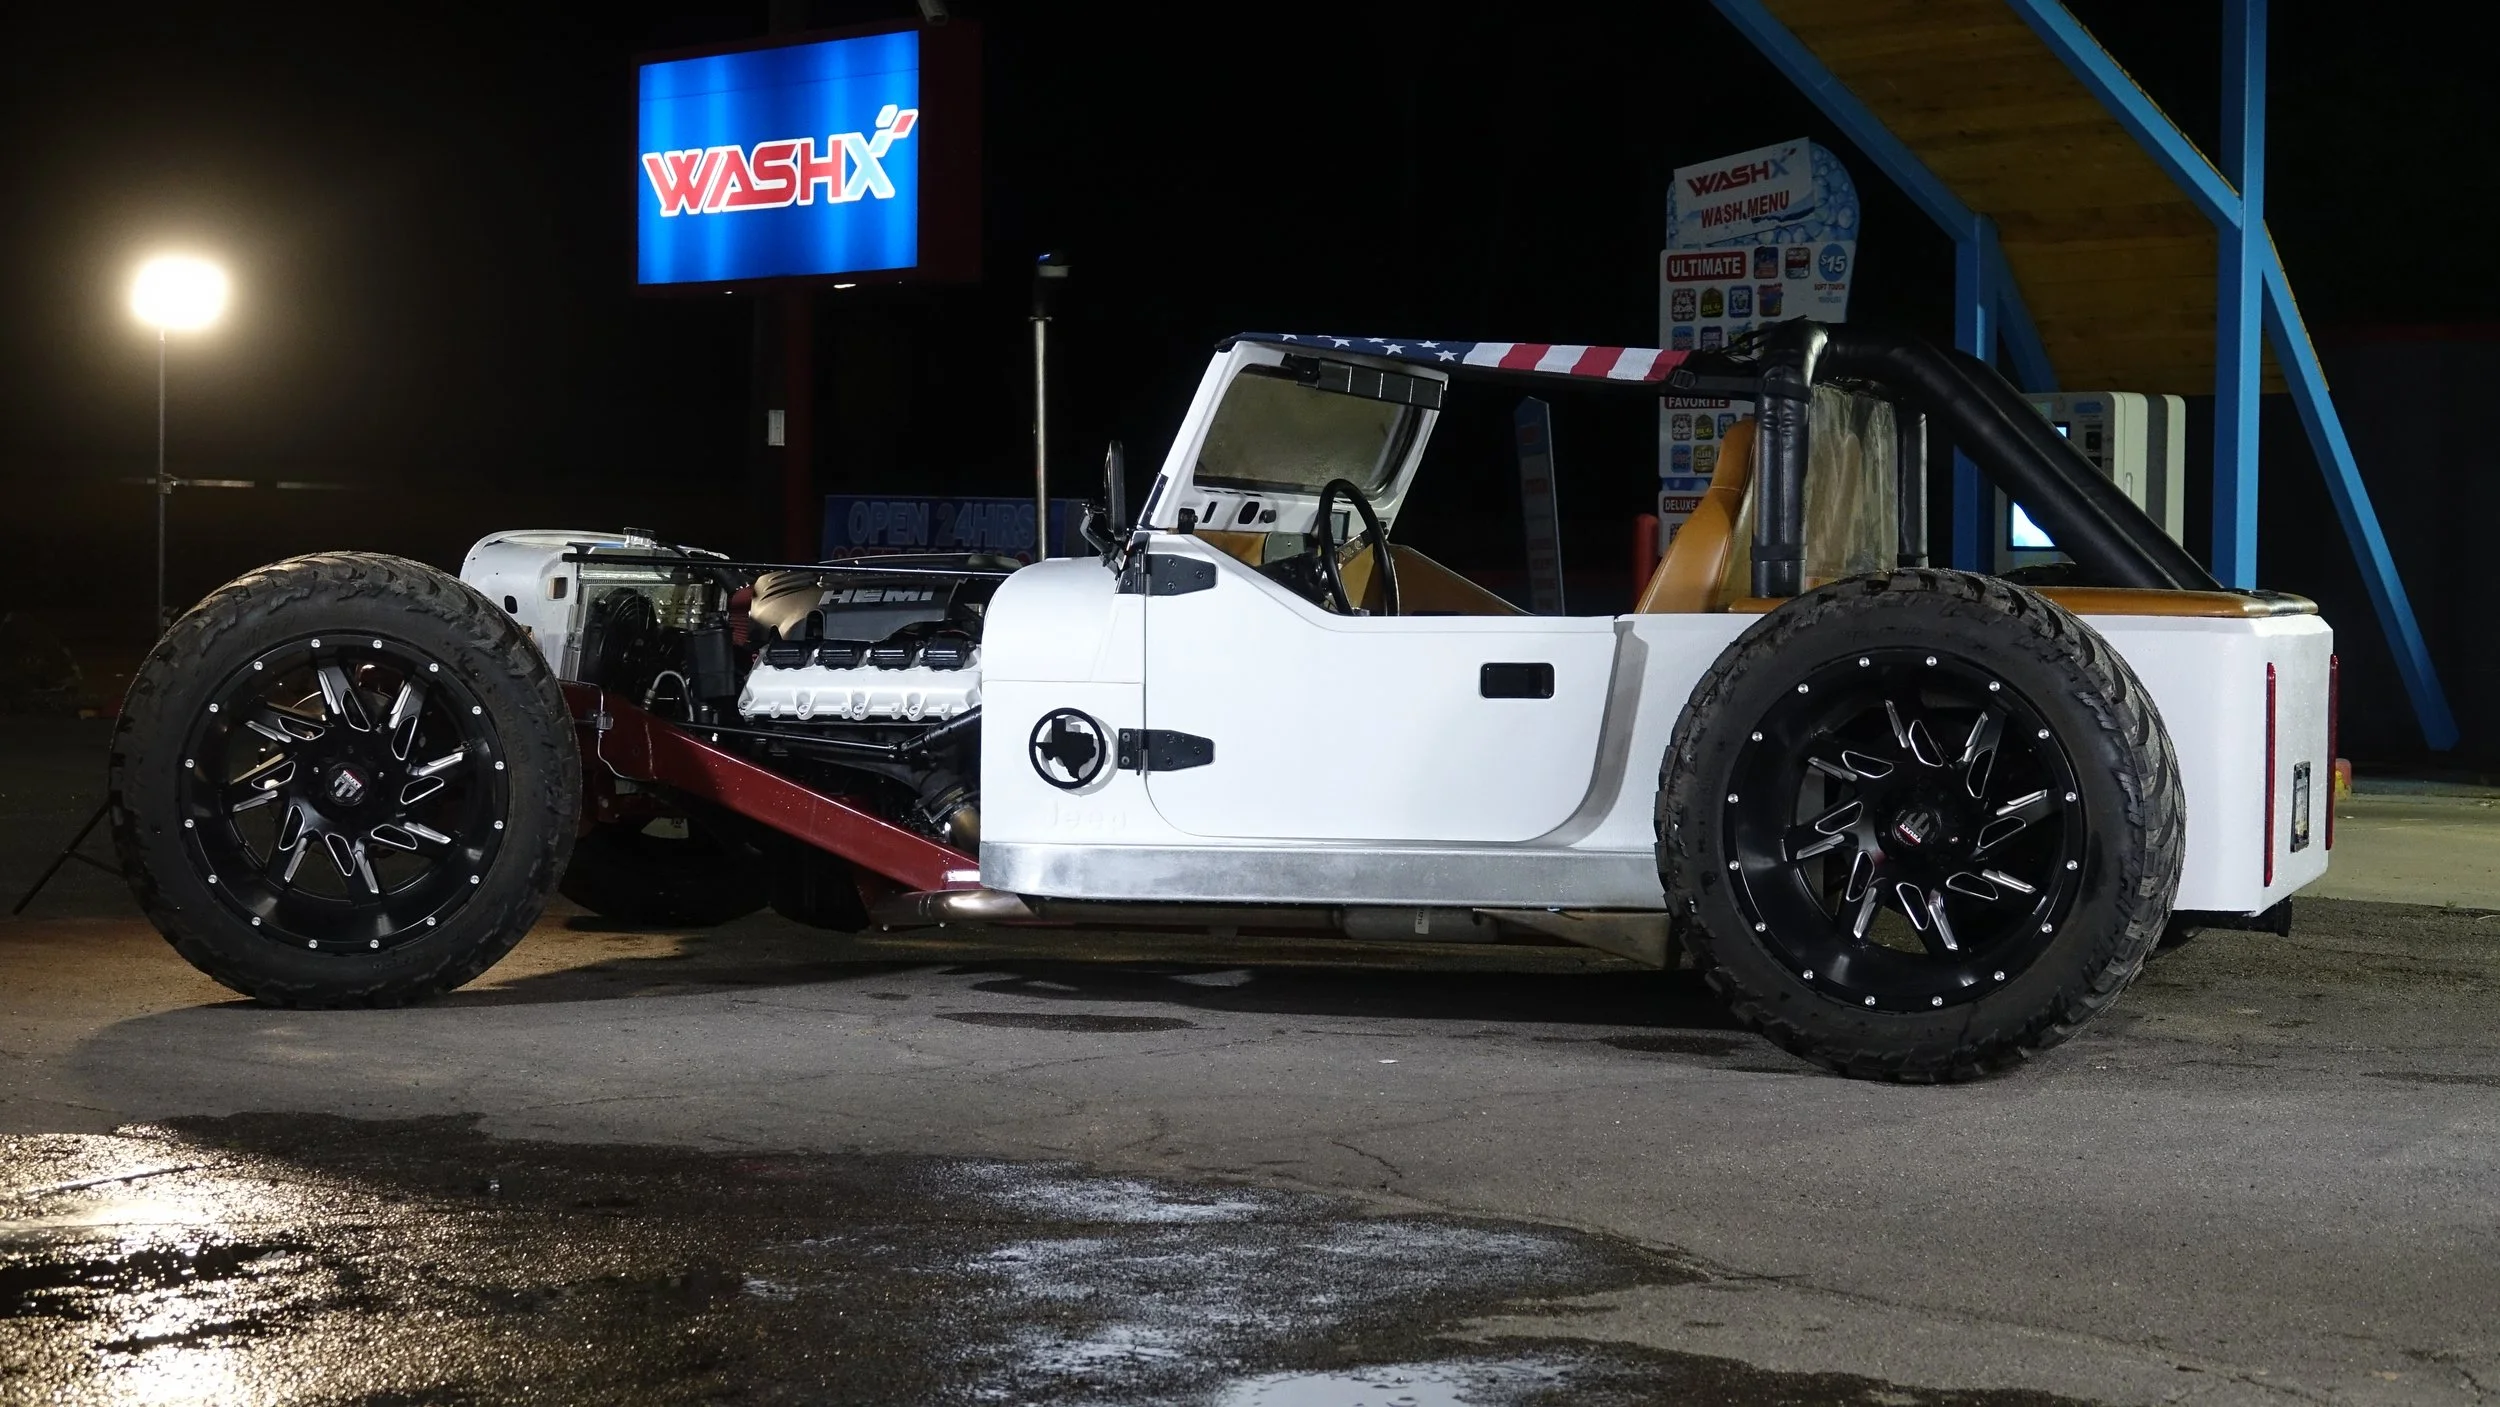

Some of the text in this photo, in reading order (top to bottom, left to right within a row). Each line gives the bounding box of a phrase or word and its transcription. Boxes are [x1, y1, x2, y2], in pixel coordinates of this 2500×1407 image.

[642, 104, 918, 217] WASHX
[1687, 148, 1797, 197] WASHX
[1671, 256, 1741, 277] ULTIMATE
[1820, 255, 1845, 274] $15
[1664, 500, 1696, 511] DELUXE
[849, 501, 1036, 549] OPEN 24HRS
[818, 588, 935, 605] HEMI
